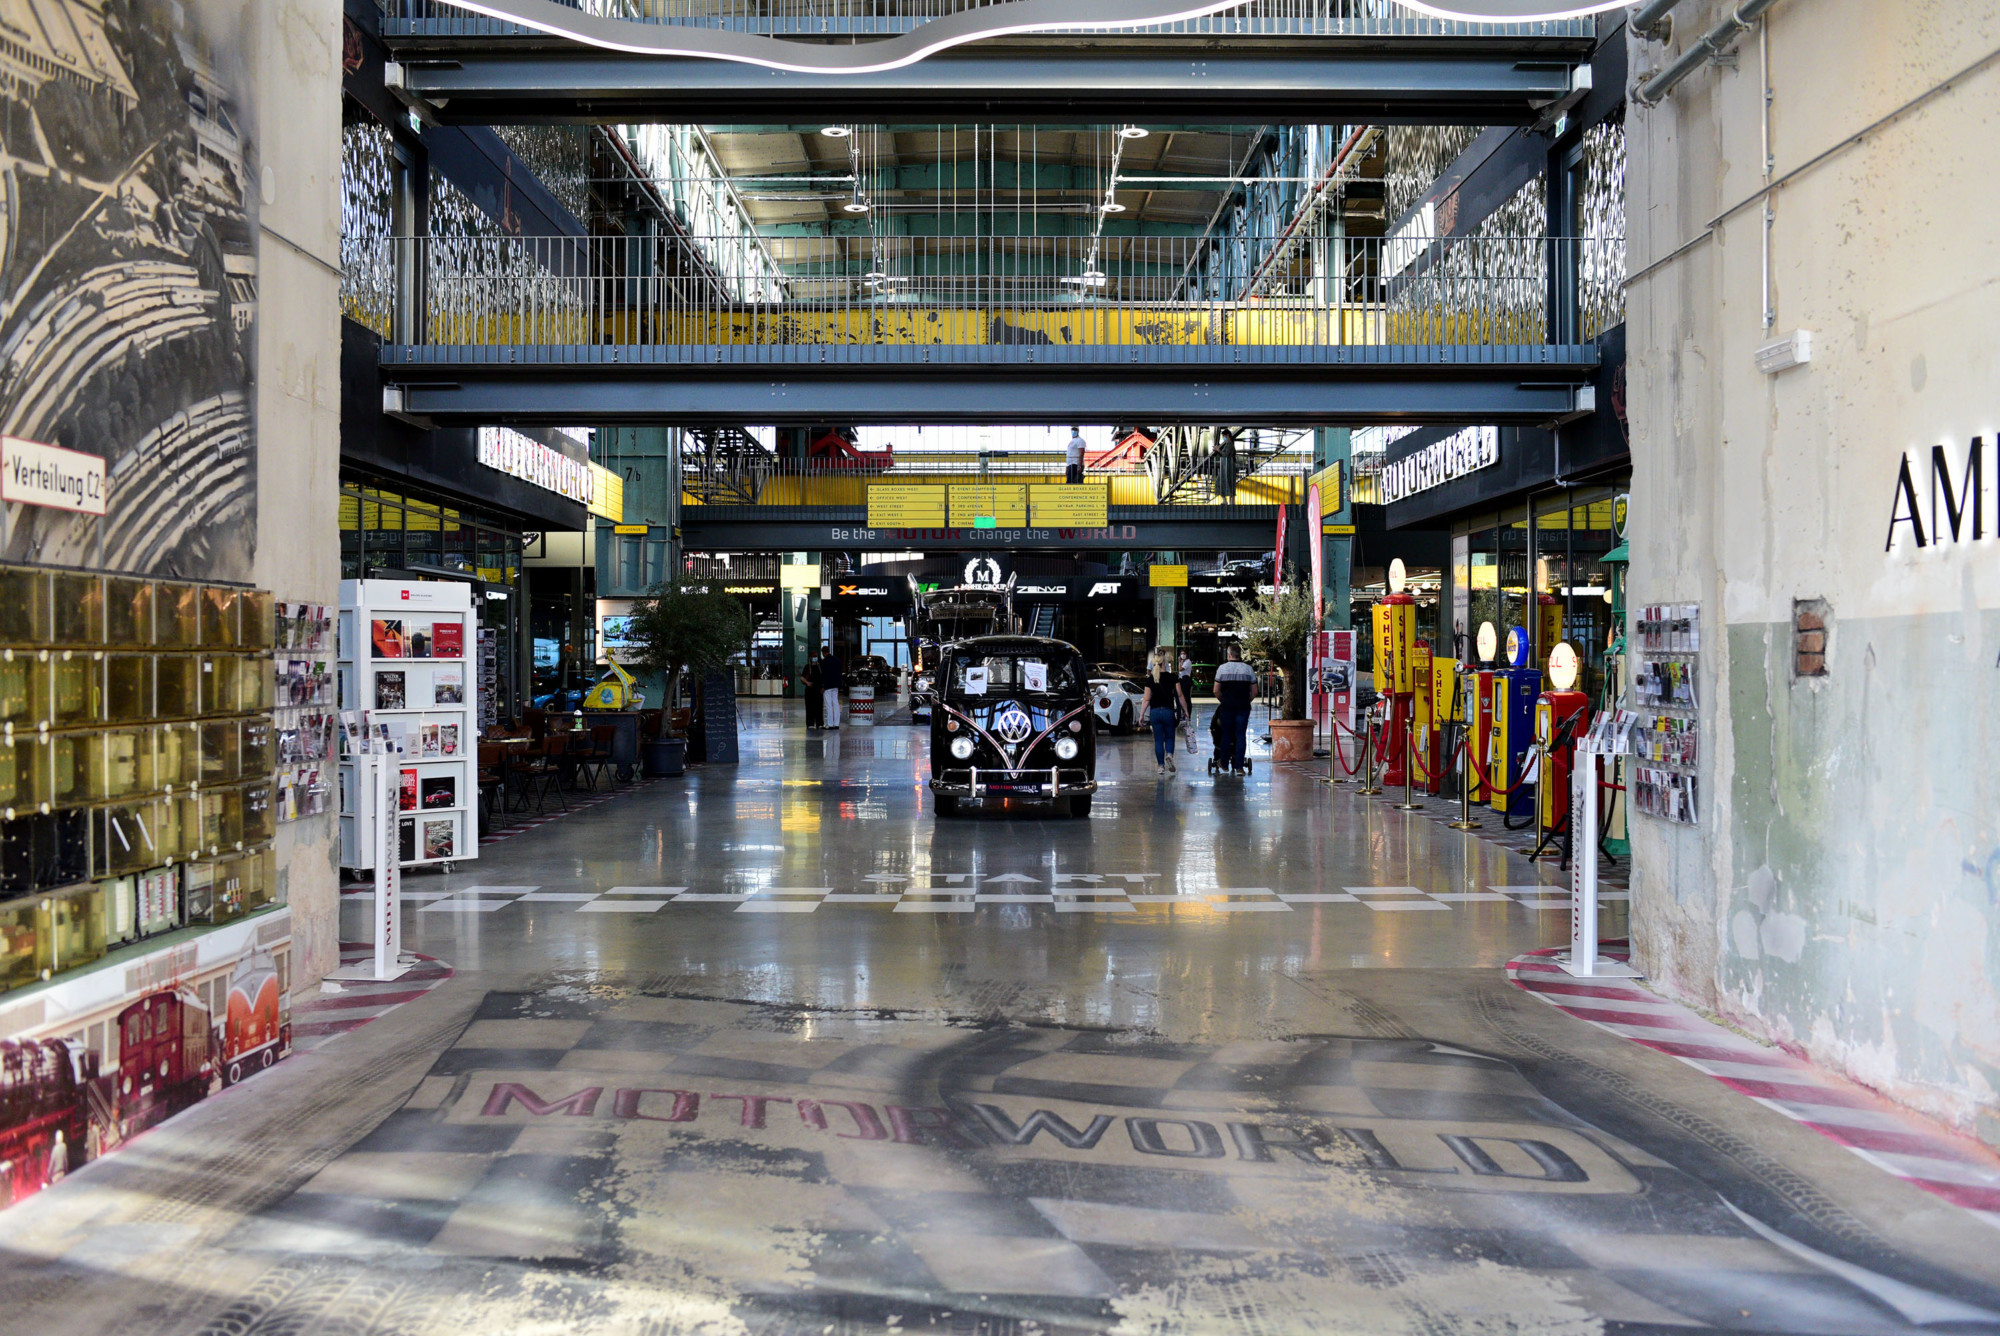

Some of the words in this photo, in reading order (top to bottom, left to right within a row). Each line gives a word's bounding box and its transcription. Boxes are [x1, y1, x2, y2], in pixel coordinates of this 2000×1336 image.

[13, 454, 84, 506] Verteilung
[87, 470, 101, 499] C2
[1885, 432, 2000, 552] AM
[1616, 503, 1626, 523] BP
[832, 528, 849, 540] Be
[853, 528, 876, 540] the
[968, 528, 1020, 543] change
[1026, 528, 1050, 540] the
[1058, 525, 1137, 540] WORLD
[724, 586, 775, 594] MANHART
[1016, 585, 1066, 594] ZENVO
[1088, 582, 1122, 598] ABT
[1435, 669, 1443, 717] SHELL
